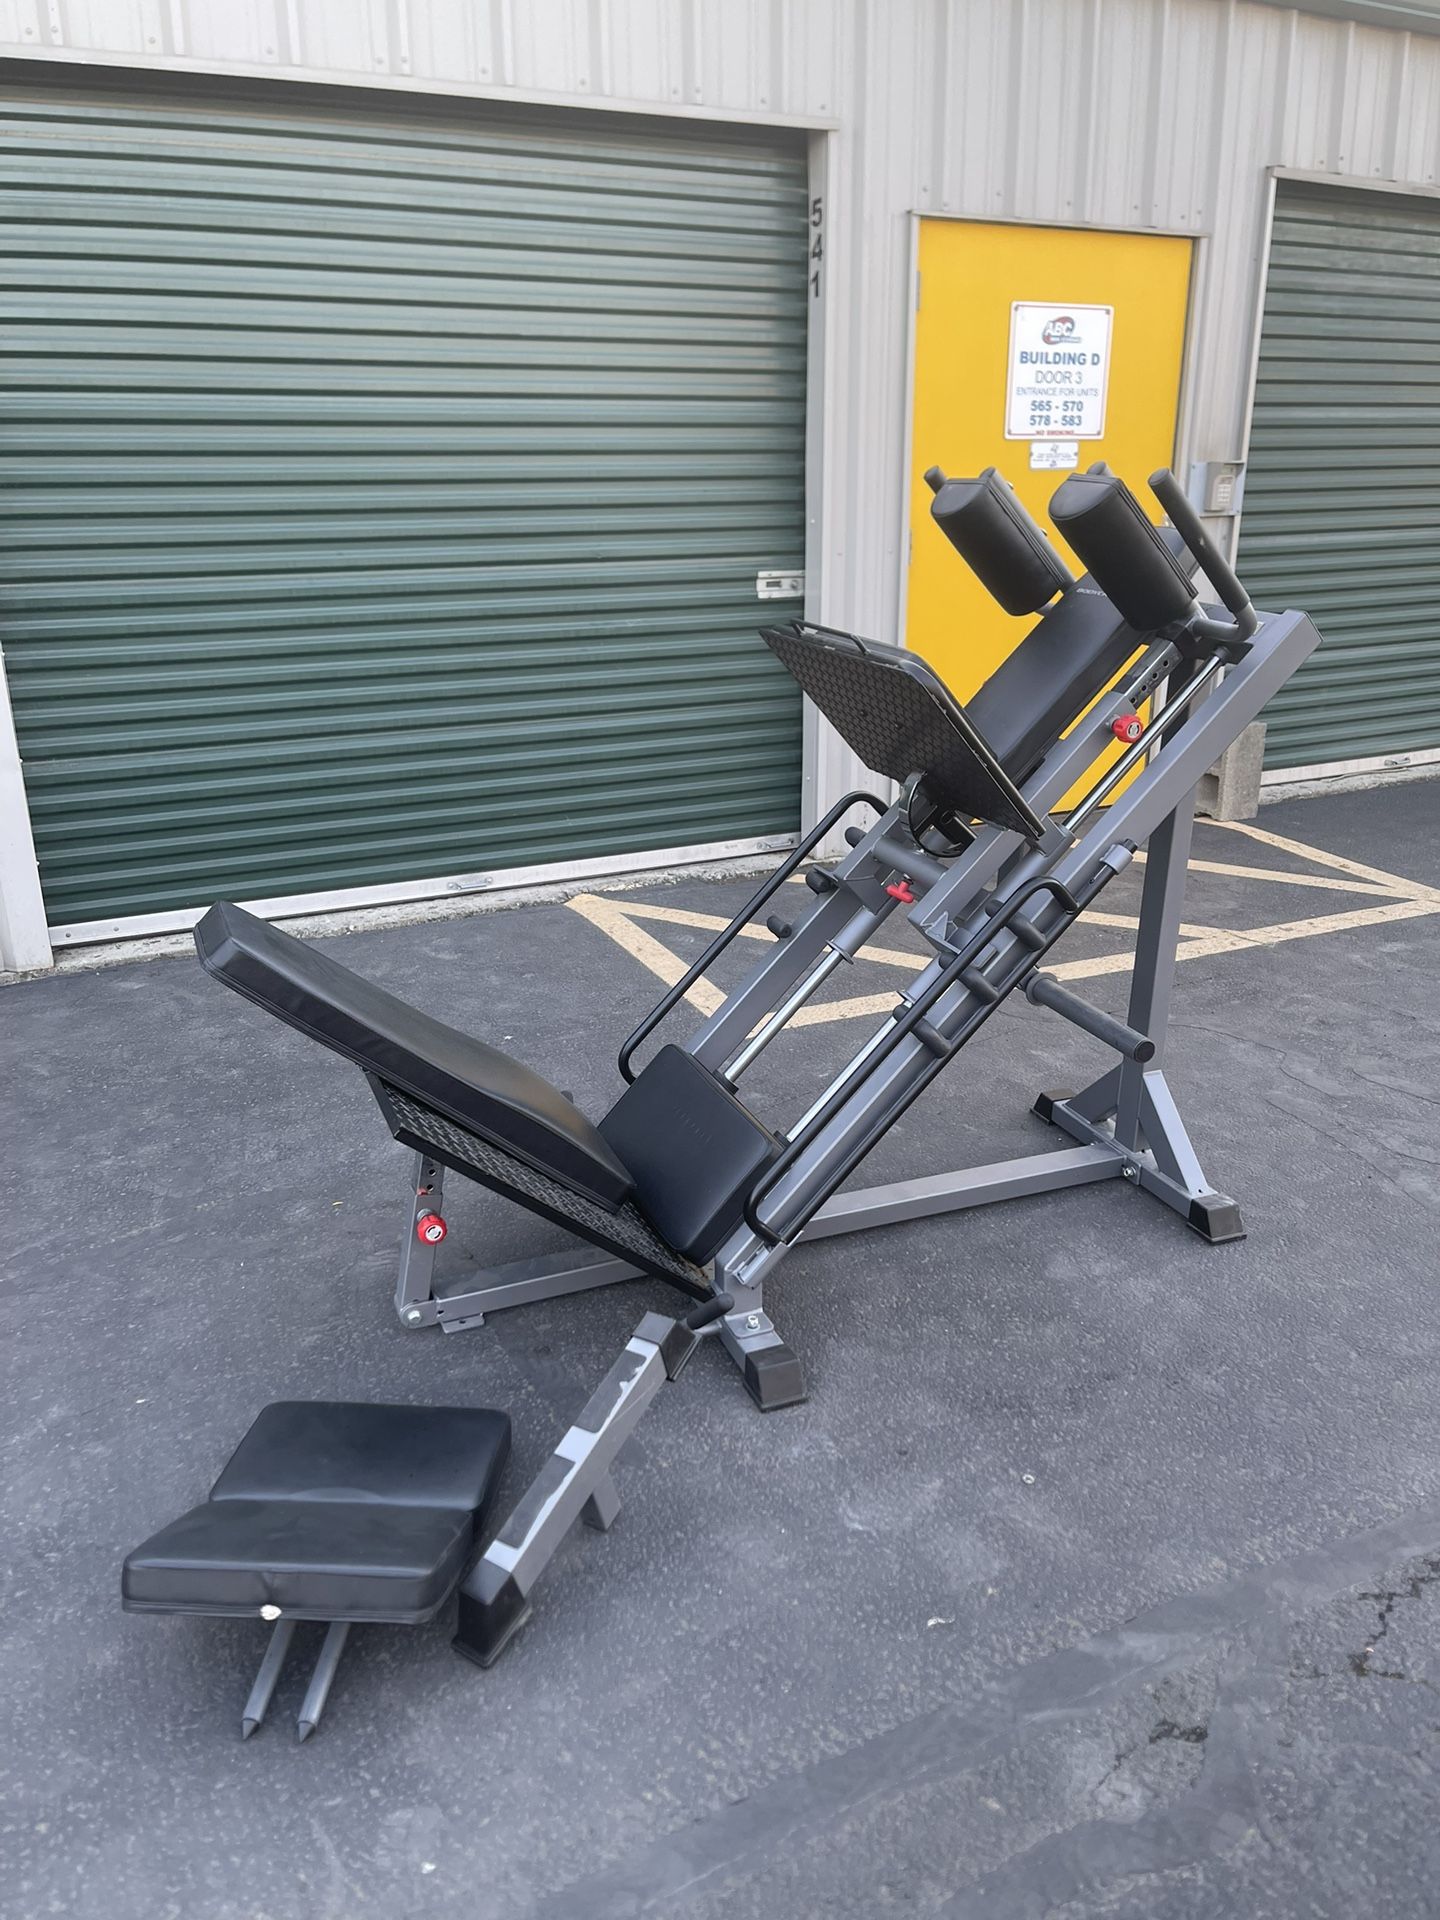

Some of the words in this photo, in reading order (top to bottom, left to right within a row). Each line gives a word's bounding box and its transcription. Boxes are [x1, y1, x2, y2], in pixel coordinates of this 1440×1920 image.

[810, 197, 824, 298] 541
[1044, 320, 1073, 337] ABC
[1019, 351, 1087, 366] BUILDING
[1091, 353, 1100, 366] D
[1035, 370, 1072, 384] DOOR
[1075, 371, 1083, 385] 3
[1016, 386, 1057, 397] ENTRANCE
[1059, 387, 1075, 397] FOR
[1076, 387, 1099, 398] UNITS
[1030, 400, 1053, 412] 565
[1062, 400, 1084, 412] 570
[1029, 414, 1051, 426] 578
[1060, 415, 1082, 426] 583
